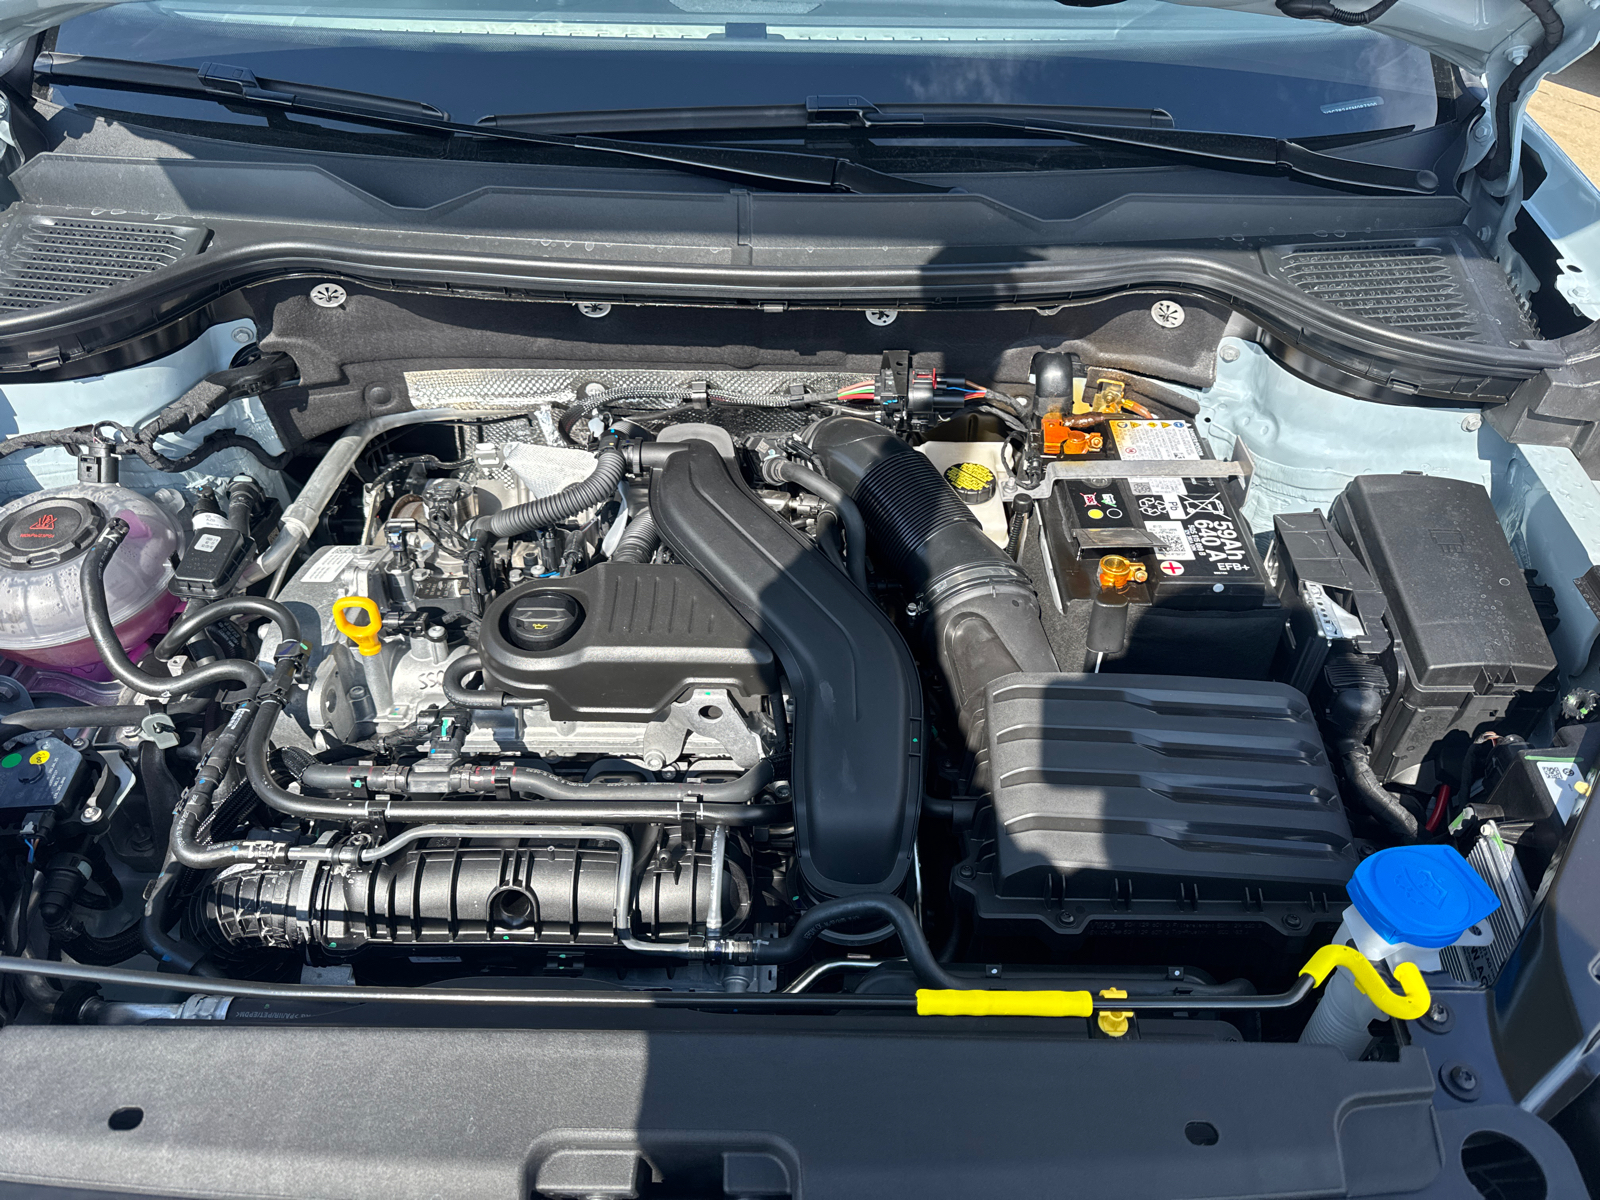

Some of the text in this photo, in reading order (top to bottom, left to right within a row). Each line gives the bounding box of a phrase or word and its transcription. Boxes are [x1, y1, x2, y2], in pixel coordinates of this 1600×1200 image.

[1168, 501, 1179, 511] Pb
[1194, 519, 1221, 546] 640
[1213, 520, 1246, 560] 59Ah
[1205, 549, 1228, 562] A
[1217, 562, 1250, 571] EFB+
